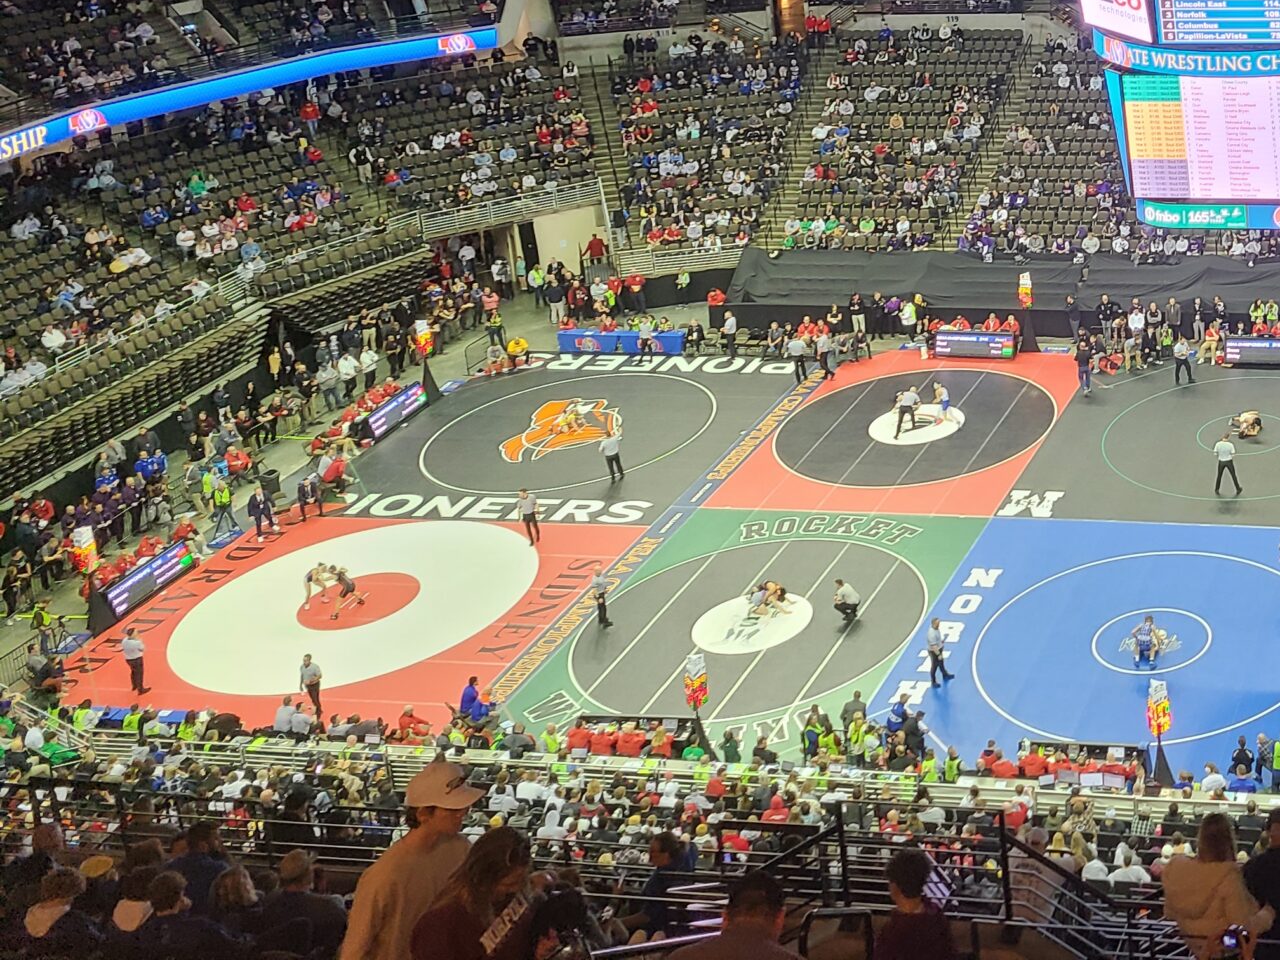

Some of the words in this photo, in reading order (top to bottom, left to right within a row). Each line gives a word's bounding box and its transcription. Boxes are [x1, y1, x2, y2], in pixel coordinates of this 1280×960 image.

[1150, 50, 1252, 72] WRESTLING
[607, 536, 664, 576] NSAA
[740, 514, 924, 545] ROCKET
[476, 558, 604, 661] SIDNEY
[490, 577, 621, 704] CAMPIONSHIPS
[888, 568, 1004, 705] NORTH
